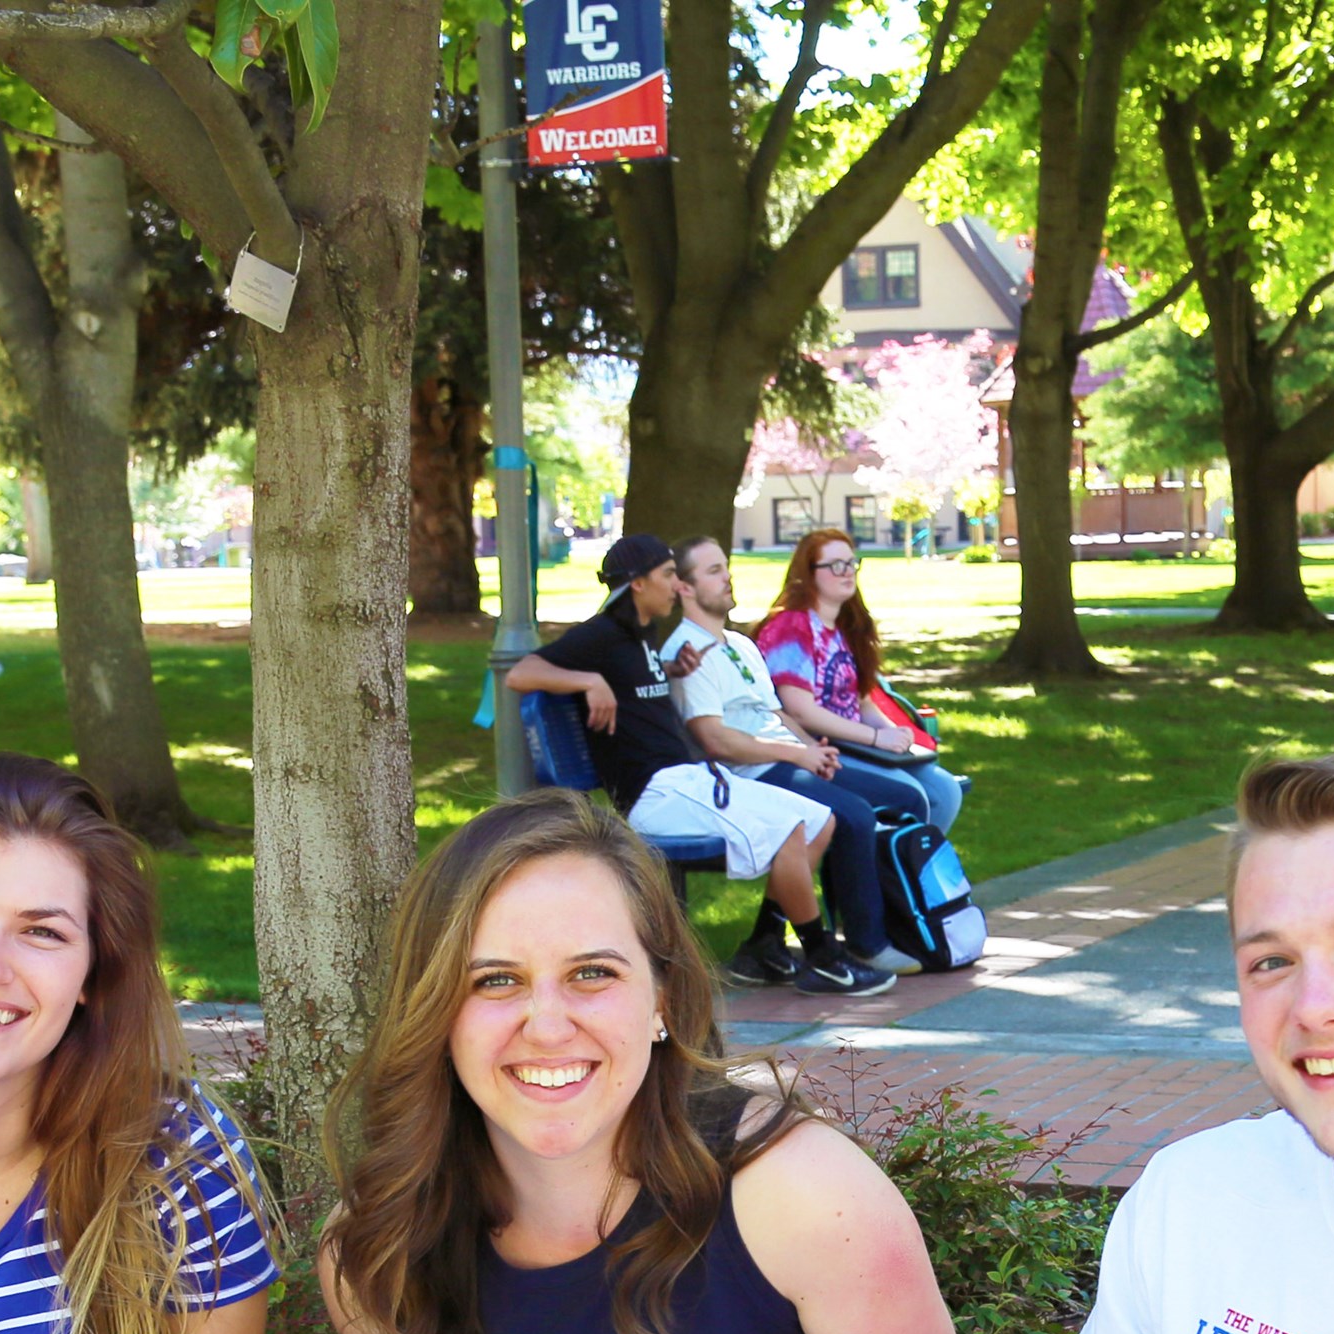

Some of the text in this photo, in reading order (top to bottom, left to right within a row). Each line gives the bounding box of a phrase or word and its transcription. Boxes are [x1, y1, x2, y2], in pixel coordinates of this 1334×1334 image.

[564, 0, 619, 61] LC
[546, 62, 641, 85] WARRIORS
[539, 125, 657, 153] WELCOME!
[1224, 1308, 1254, 1333] THE
